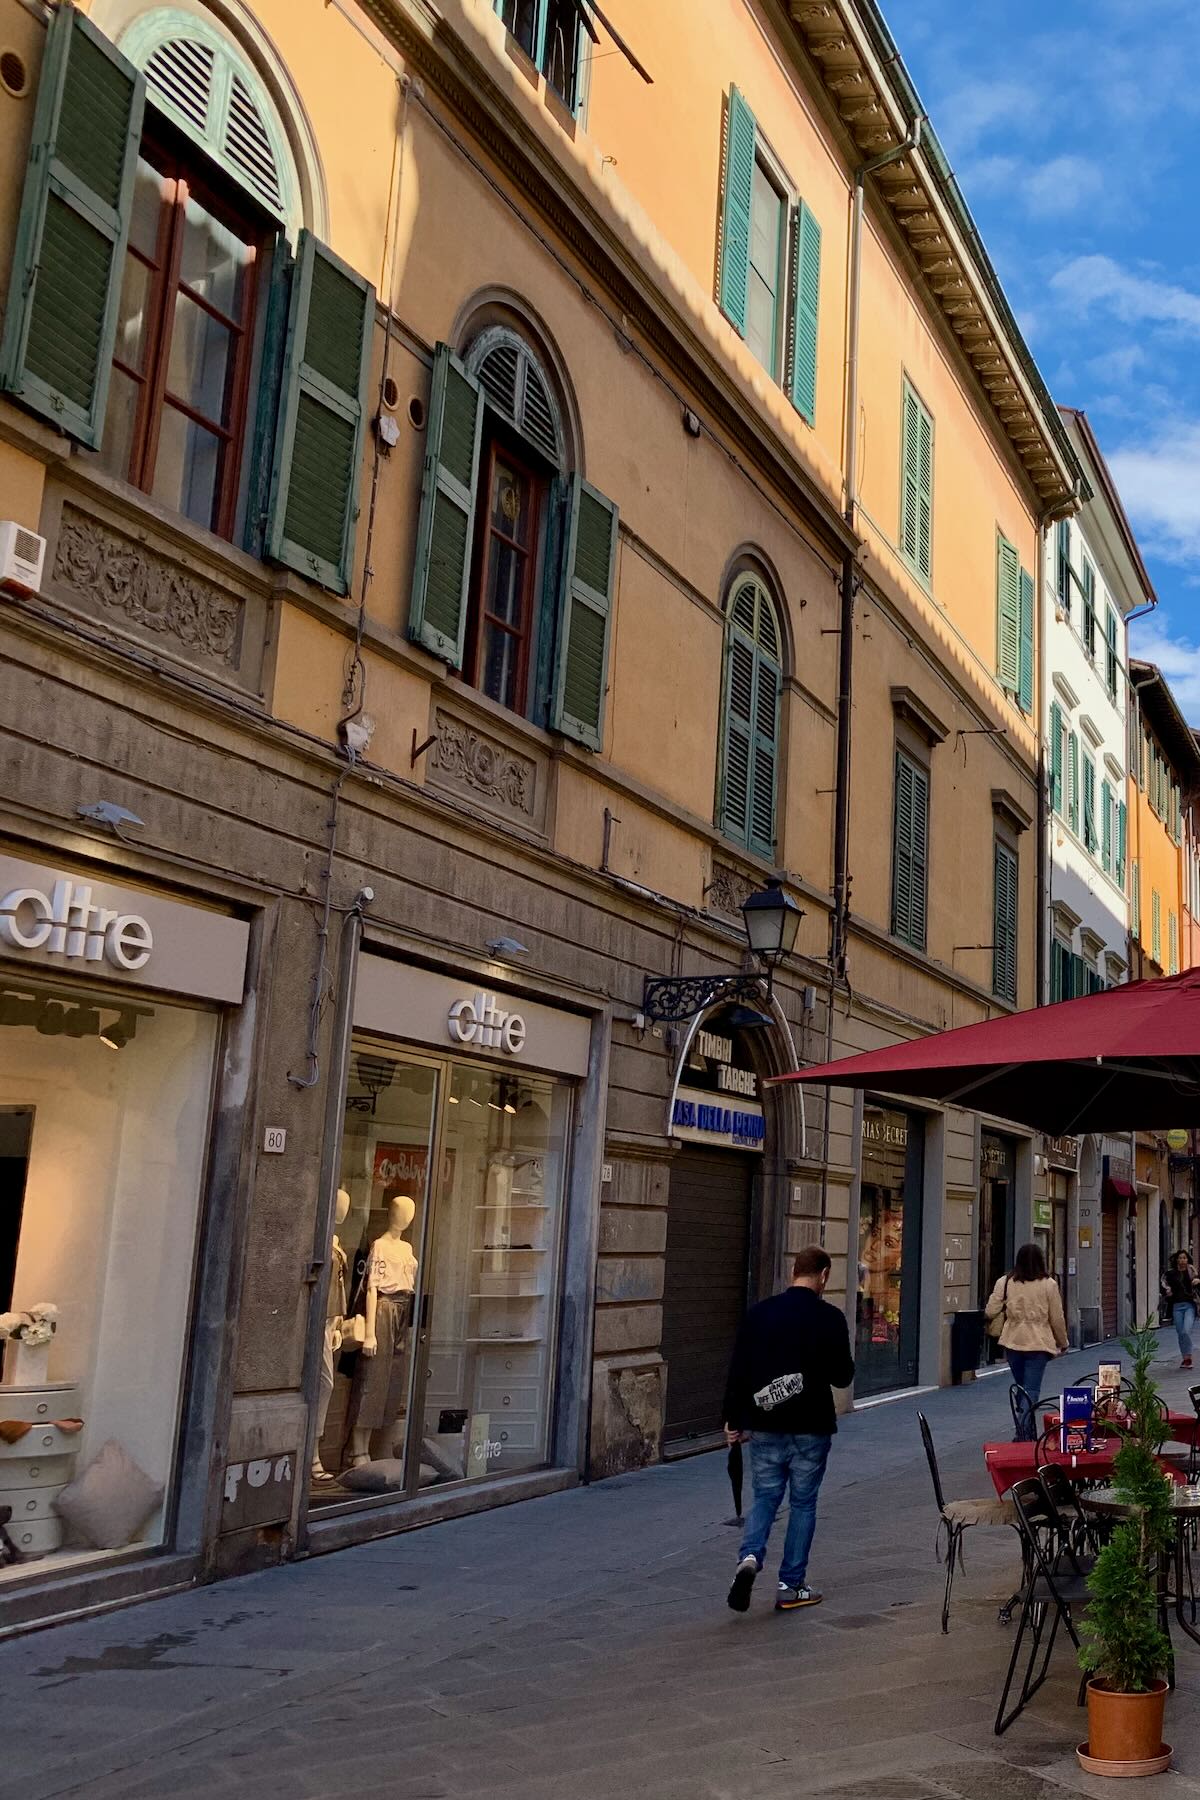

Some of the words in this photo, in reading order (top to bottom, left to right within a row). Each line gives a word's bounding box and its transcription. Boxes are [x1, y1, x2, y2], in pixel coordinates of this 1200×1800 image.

[0, 880, 153, 971] oltre
[448, 992, 527, 1054] oltre
[698, 1030, 732, 1063] TIMBRI
[718, 1064, 757, 1097] TARGHE
[674, 1099, 697, 1128] ASA
[268, 1132, 282, 1148] 80
